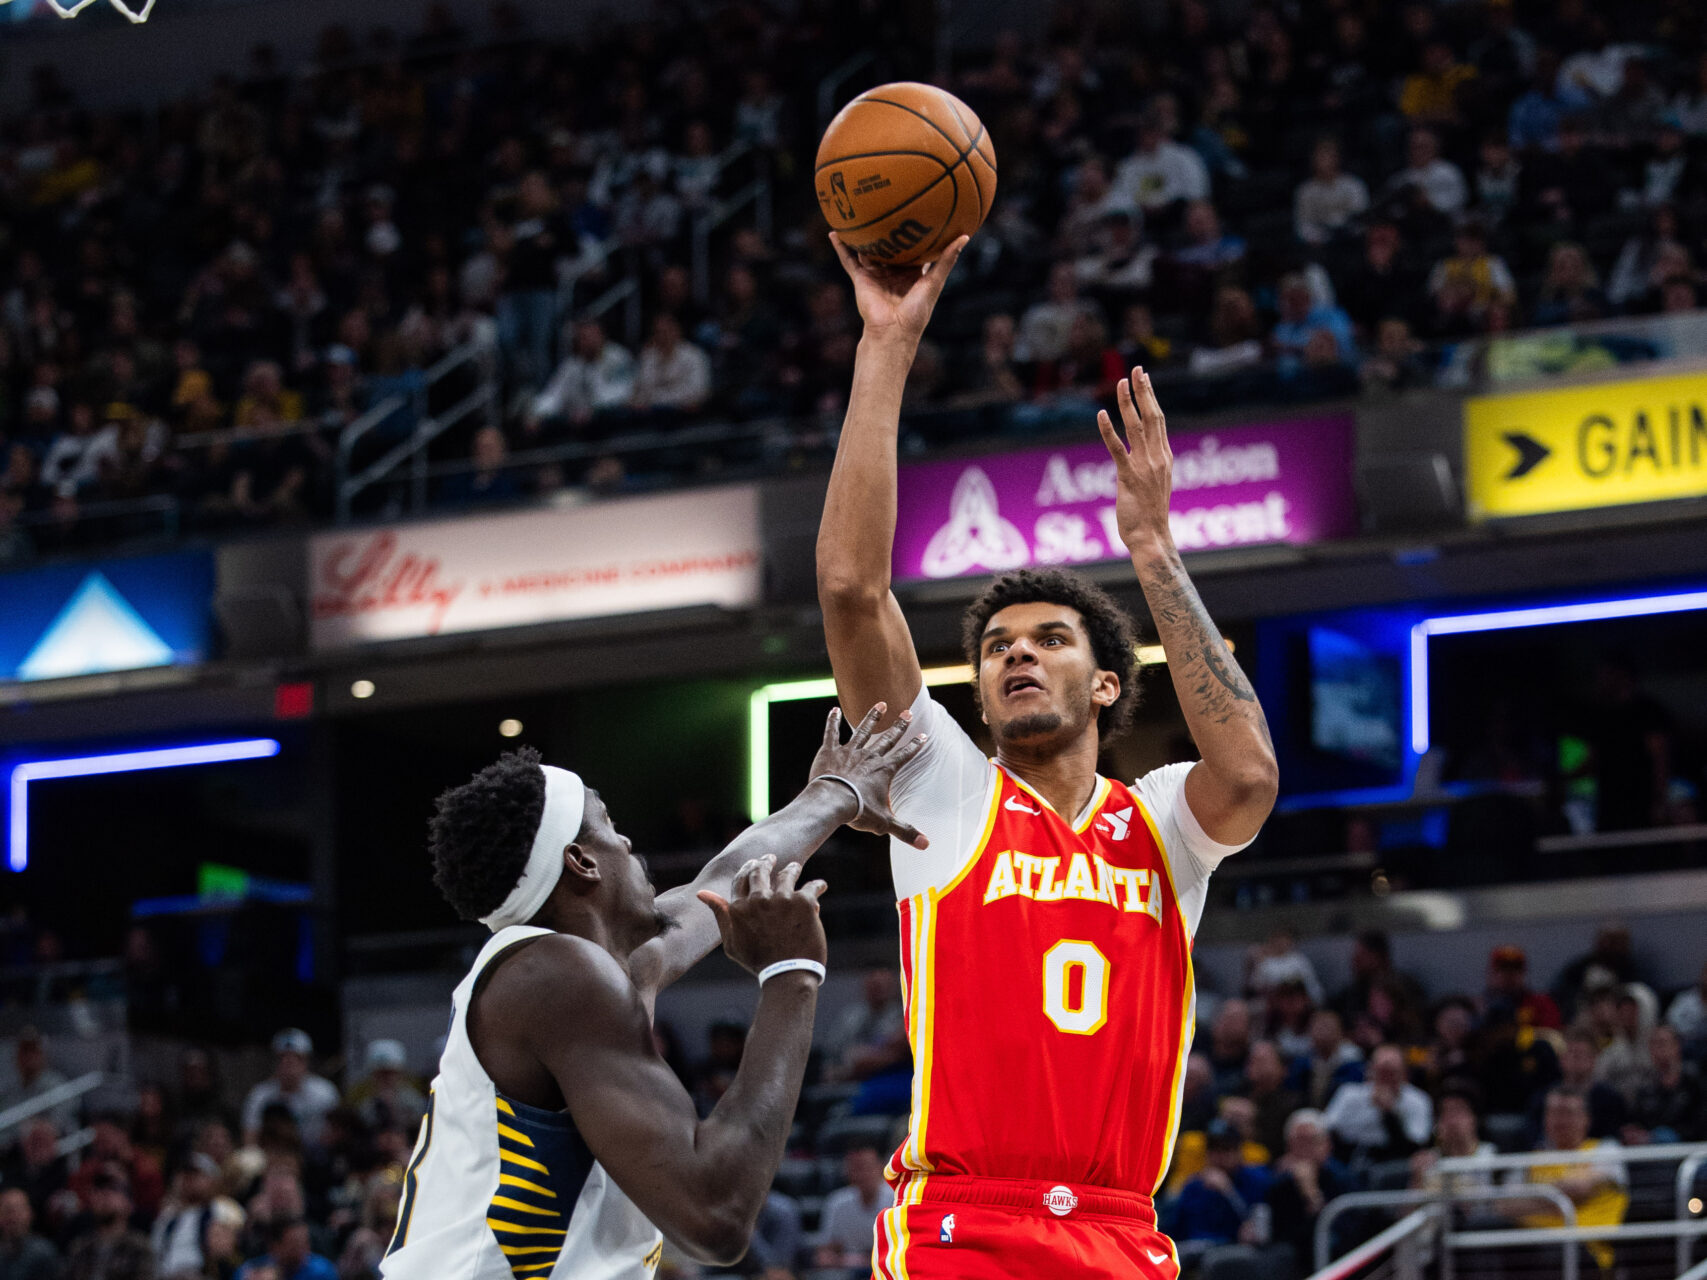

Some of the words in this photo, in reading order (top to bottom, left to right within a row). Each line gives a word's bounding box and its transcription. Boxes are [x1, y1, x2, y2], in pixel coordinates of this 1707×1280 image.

[1036, 438, 1278, 505] Ascsion
[1098, 491, 1290, 557] Vcent
[982, 850, 1163, 928] ATLANTA
[1042, 938, 1111, 1036] 0
[1043, 1193, 1078, 1209] HAWKS
